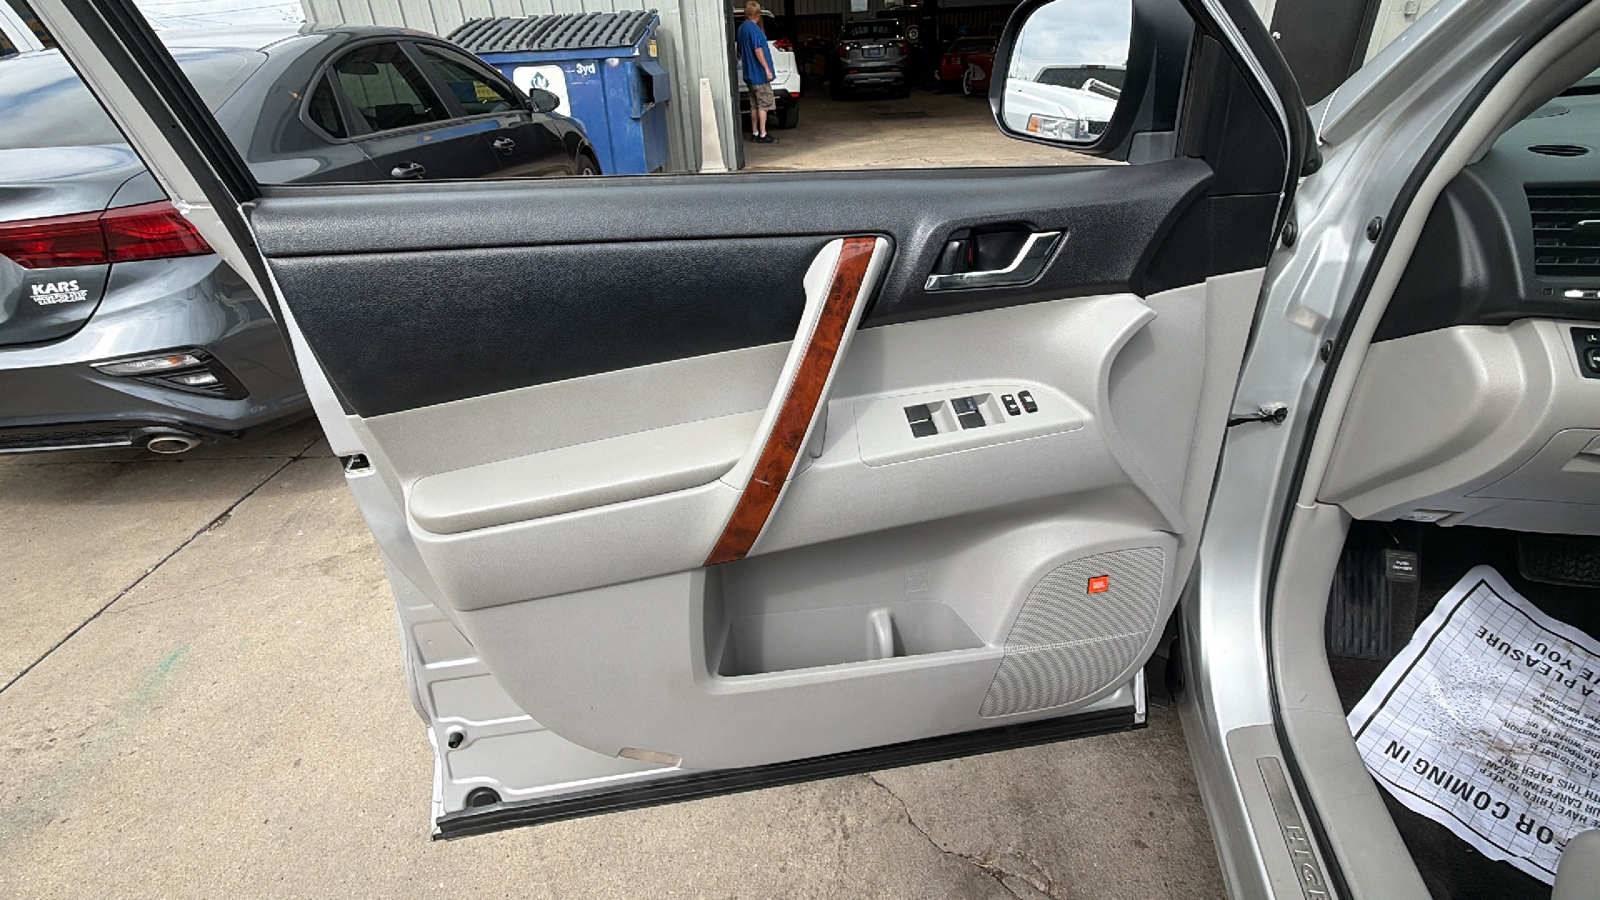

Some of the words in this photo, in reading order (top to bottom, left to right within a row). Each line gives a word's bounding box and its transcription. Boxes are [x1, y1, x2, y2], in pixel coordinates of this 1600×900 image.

[576, 63, 595, 75] 3yd
[31, 280, 79, 296] KARS
[1475, 626, 1577, 688] PLEASURE
[1533, 642, 1572, 671] YOU
[1582, 685, 1594, 697] A
[1540, 692, 1580, 715] welcome
[1504, 721, 1539, 739] person
[1541, 728, 1551, 736] to
[1529, 742, 1538, 751] is
[1553, 732, 1581, 749] world
[1384, 740, 1410, 764] IN
[1540, 737, 1587, 763] important
[1498, 755, 1520, 770] MAT
[1541, 747, 1587, 773] customer
[1480, 767, 1505, 783] KEEP
[1486, 760, 1518, 780] CLEAN
[1521, 764, 1553, 783] PAPER
[1413, 757, 1510, 820] COMING
[1508, 782, 1520, 792] TO
[1521, 778, 1582, 808] CARPETING
[1557, 778, 1581, 794] THIS
[1523, 789, 1557, 812] TRIED
[1558, 806, 1588, 823] HAVE
[1515, 813, 1571, 850] FOR
